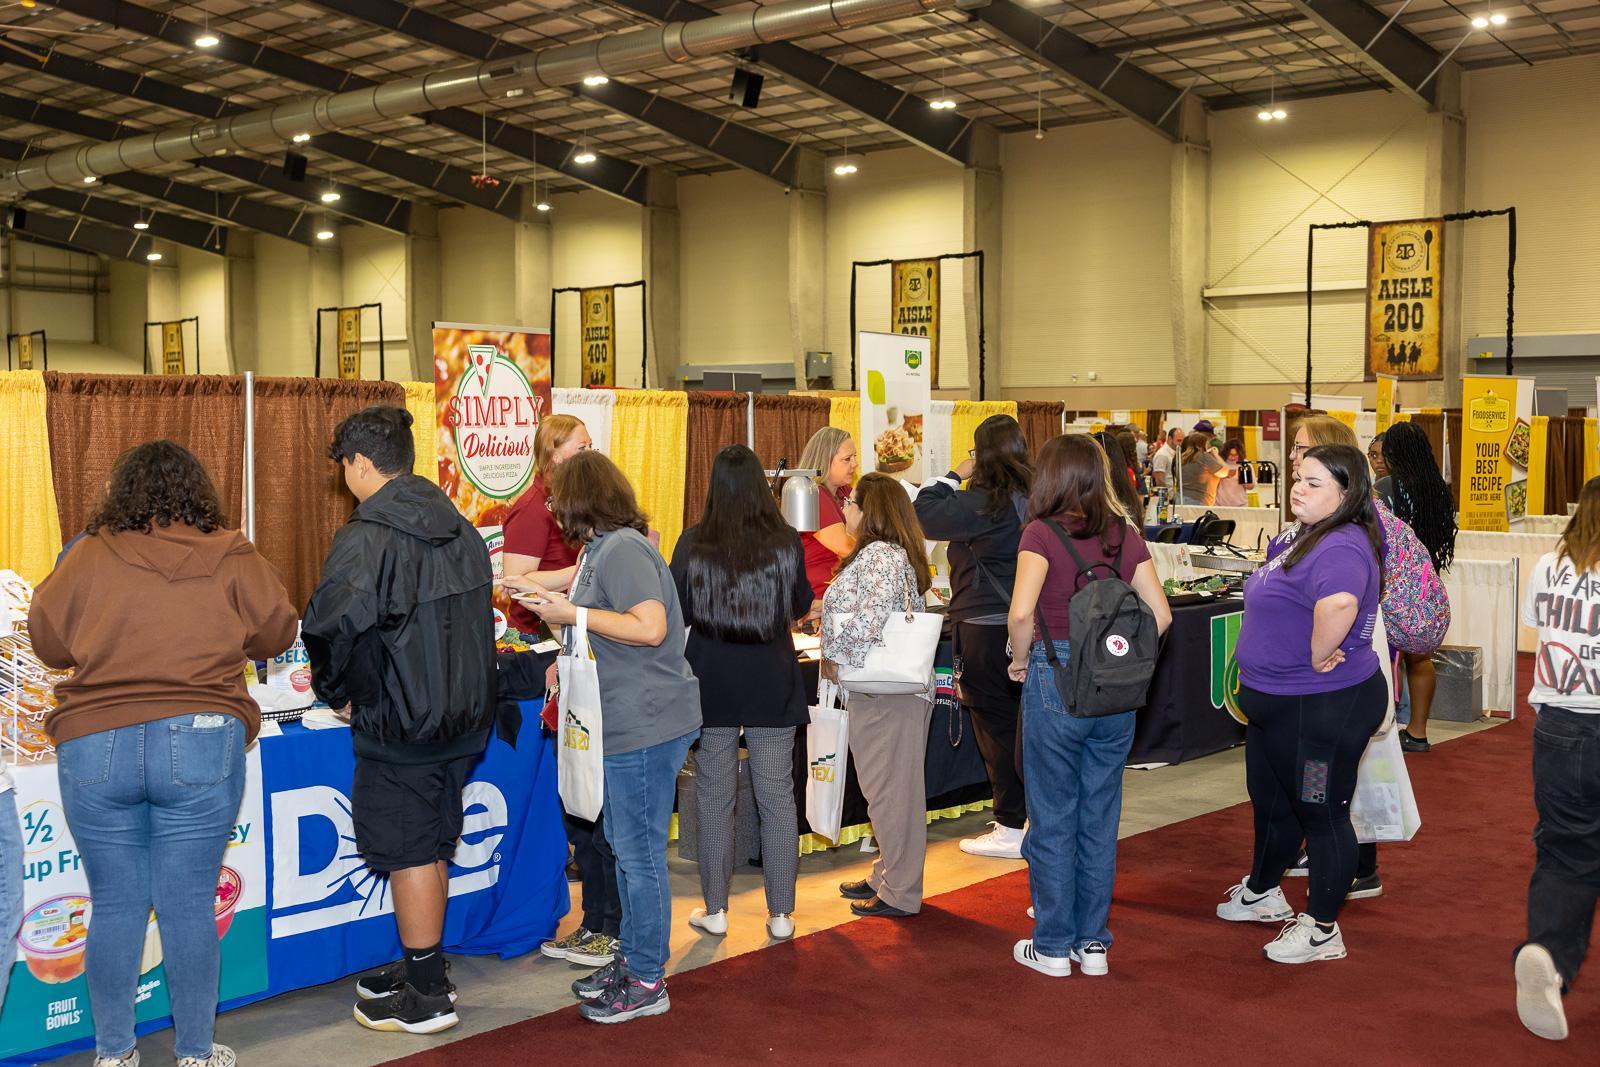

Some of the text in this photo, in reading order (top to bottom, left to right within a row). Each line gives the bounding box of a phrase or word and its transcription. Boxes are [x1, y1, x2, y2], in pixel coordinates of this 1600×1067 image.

[1378, 277, 1433, 300] AISLE
[898, 306, 933, 324] AISLE
[1384, 302, 1424, 332] 200
[585, 327, 610, 341] AISLE
[588, 343, 608, 363] 400
[449, 396, 544, 427] SIMPLY
[463, 432, 532, 459] Delicious
[1476, 443, 1500, 457] YOUR
[1476, 460, 1499, 474] BEST
[1471, 477, 1503, 491] RECIPE
[1470, 493, 1502, 501] STARTS HERE
[1546, 565, 1600, 600] WE AR
[274, 649, 309, 665] GELS
[229, 822, 251, 843] sy
[271, 781, 508, 910] De
[22, 849, 82, 882] up Fr
[48, 996, 78, 1016] FRUIT
